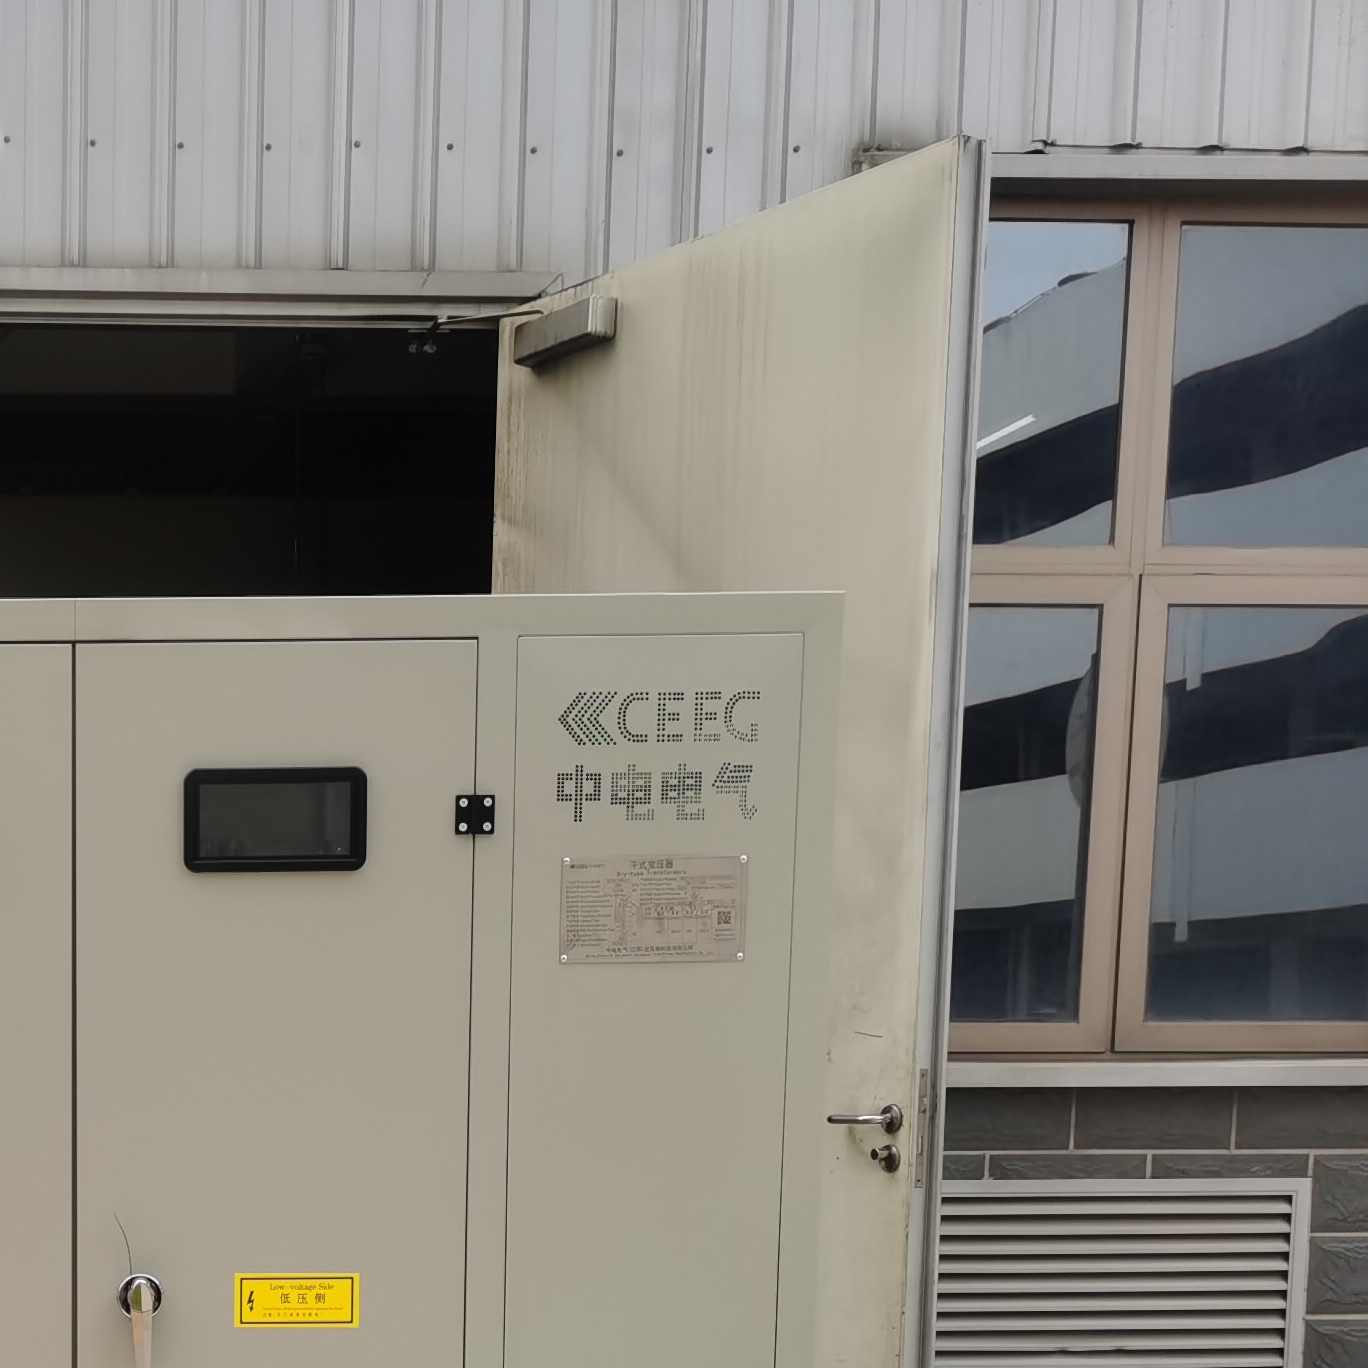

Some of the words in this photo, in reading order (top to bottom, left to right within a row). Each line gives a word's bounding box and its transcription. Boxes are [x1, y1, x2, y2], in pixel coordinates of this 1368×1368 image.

[617, 690, 761, 744] CEEG
[556, 761, 758, 823] 中电电气
[631, 859, 674, 869] 干式变压器
[318, 1283, 335, 1291] Side
